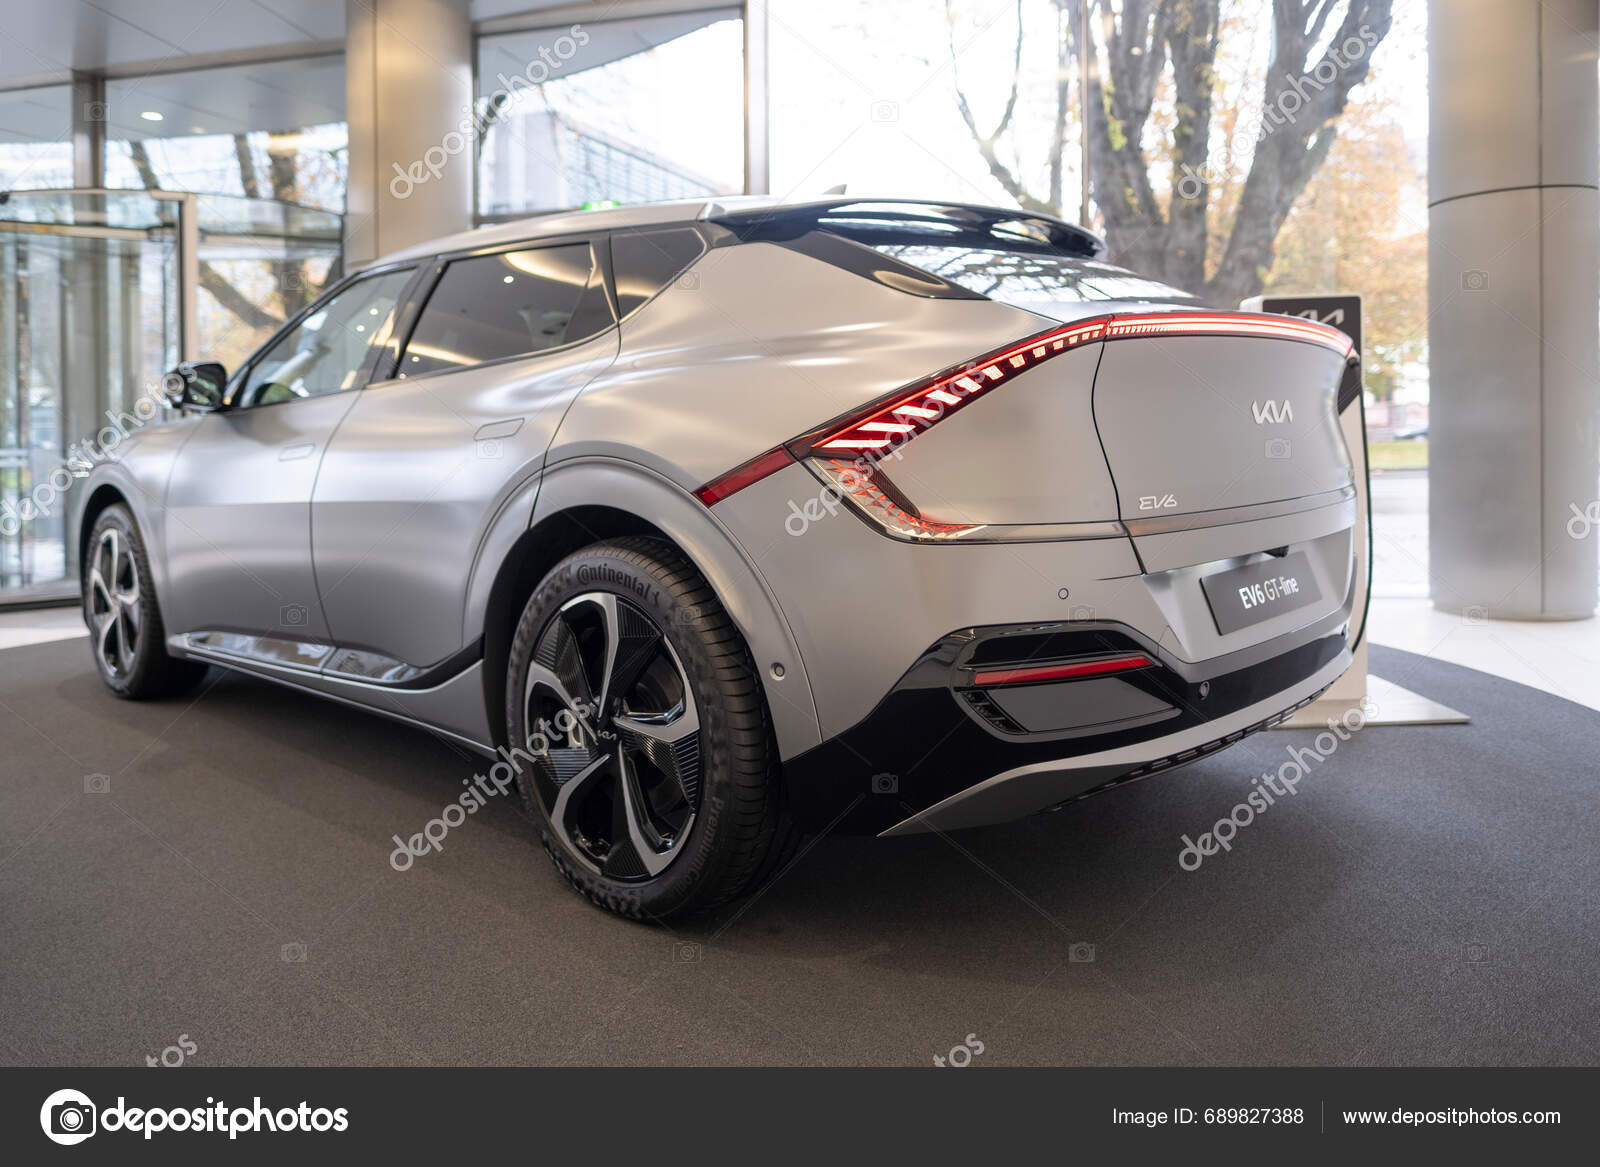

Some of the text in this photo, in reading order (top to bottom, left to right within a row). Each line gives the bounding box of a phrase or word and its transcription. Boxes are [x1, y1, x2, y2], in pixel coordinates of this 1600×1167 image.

[1139, 494, 1177, 510] EV6
[577, 562, 652, 600] Continental
[1239, 576, 1300, 609] EV6 GT-line
